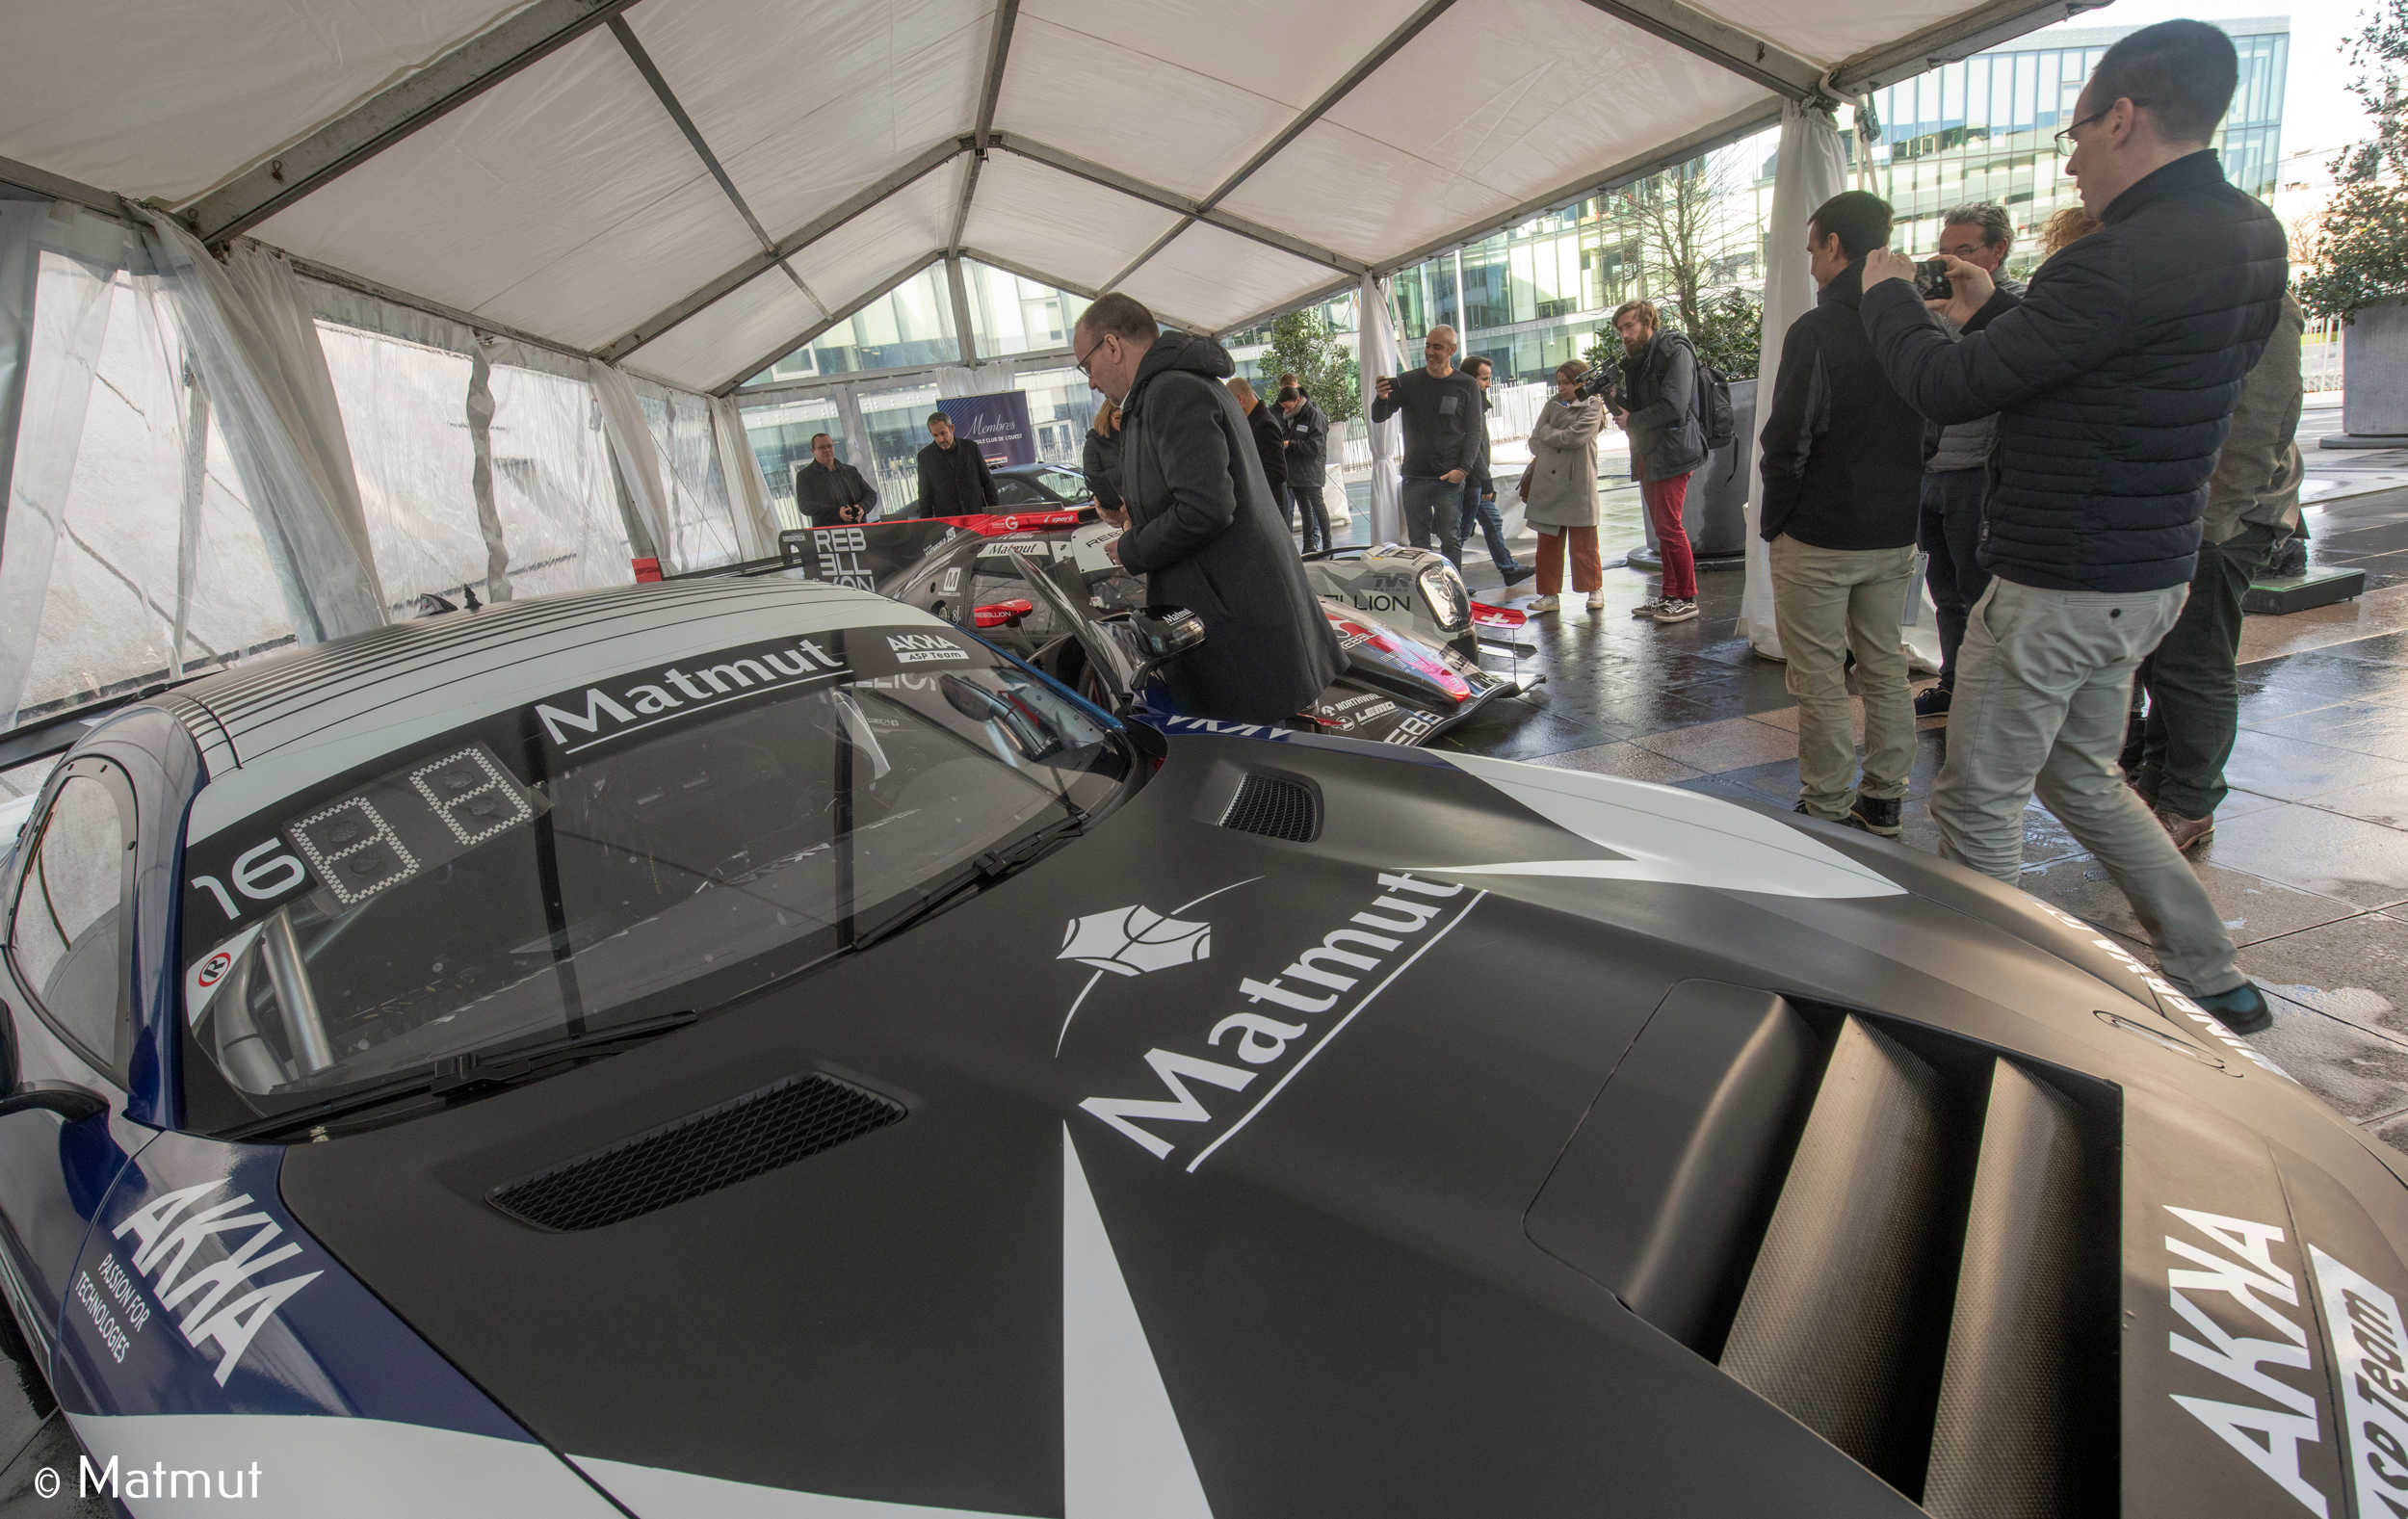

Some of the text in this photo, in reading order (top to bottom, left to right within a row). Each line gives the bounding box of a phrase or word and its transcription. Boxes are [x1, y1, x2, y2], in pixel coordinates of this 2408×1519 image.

[963, 412, 1016, 439] Membres
[813, 527, 867, 554] REB
[886, 635, 961, 651] AKKA
[1322, 594, 1411, 612] LION
[535, 639, 845, 745] Matmut
[909, 651, 961, 661] ASP Team
[191, 837, 305, 921] 16
[204, 958, 225, 979] R
[1079, 873, 1464, 1161] Matmut
[75, 1270, 130, 1364] TECHNOLOGIES
[98, 1252, 151, 1333] PASSION FOR
[112, 1176, 325, 1388] AKKA
[2161, 1205, 2331, 1519] AKKA
